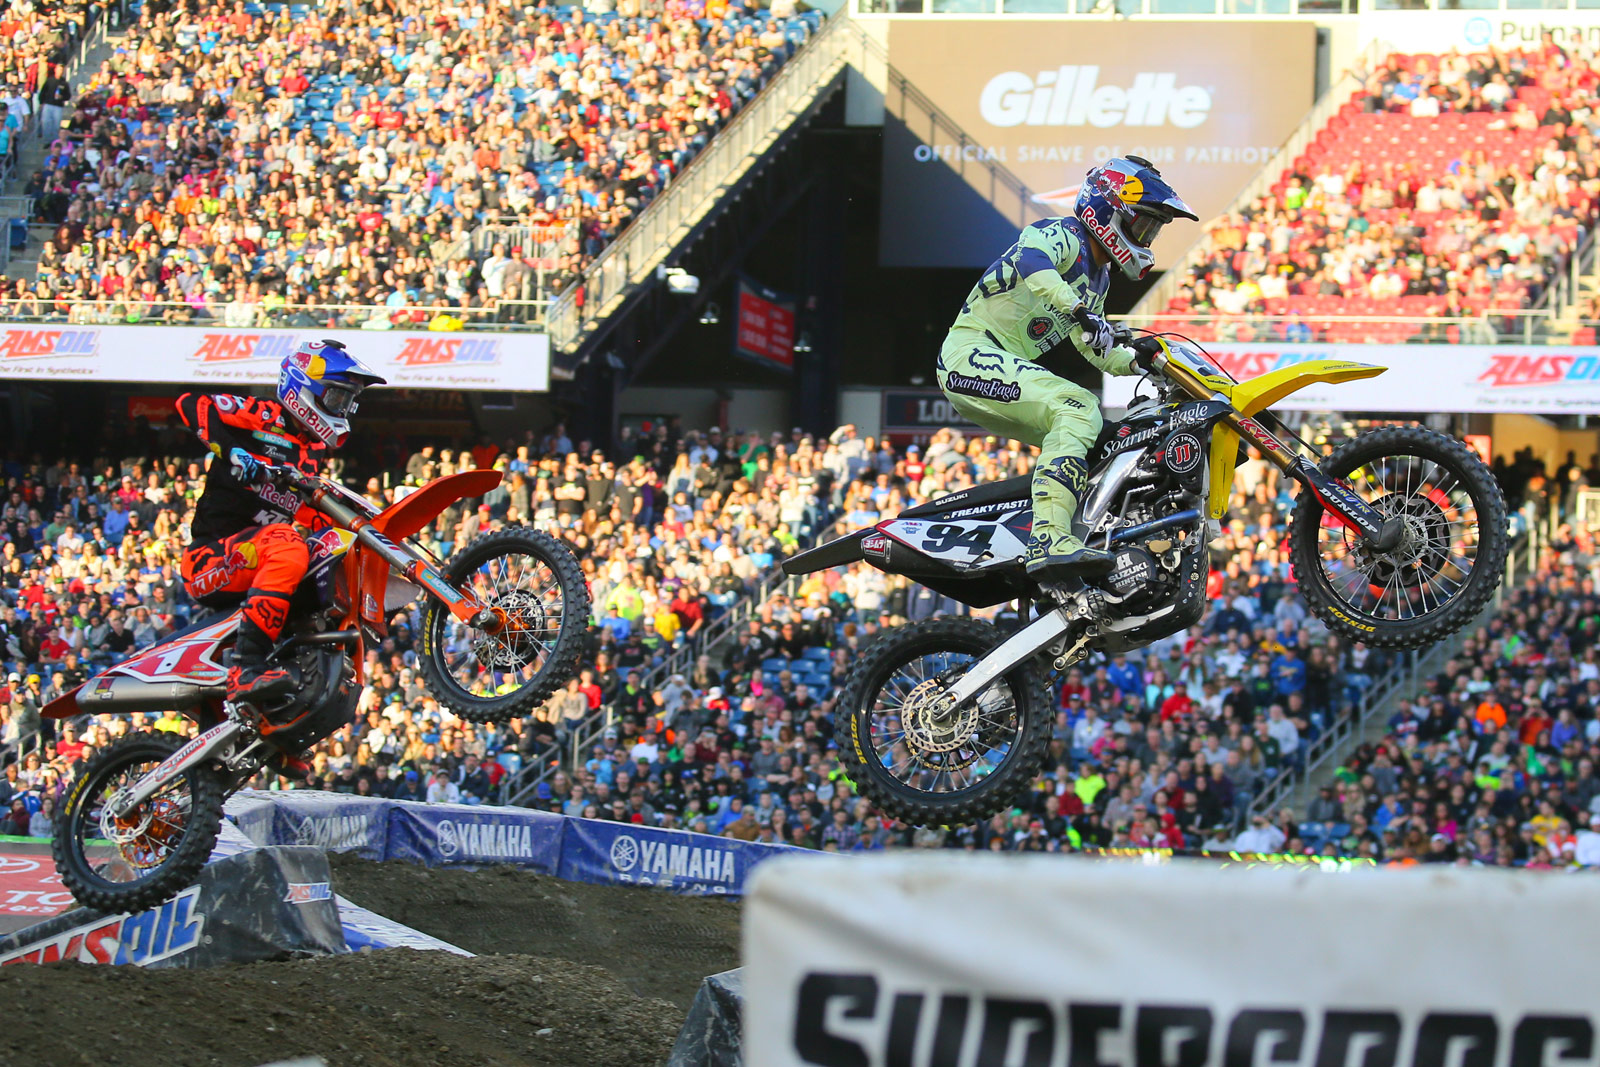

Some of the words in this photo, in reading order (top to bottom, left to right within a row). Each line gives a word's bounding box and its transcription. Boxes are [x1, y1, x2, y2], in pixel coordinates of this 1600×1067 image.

[980, 65, 1212, 128] Gillette
[914, 145, 1007, 163] OFFICIAL
[1018, 145, 1083, 162] SHAVE
[1080, 205, 1111, 238] Red
[0, 330, 96, 358] AMSOIL
[194, 333, 296, 361] AMSOIL
[394, 338, 497, 366] AMSOIL
[948, 371, 992, 395] Soaring
[989, 380, 1021, 401] Eagle
[283, 388, 311, 417] Red
[305, 410, 334, 441] Bull
[1169, 402, 1208, 431] Eagle
[1101, 425, 1161, 460] Soaring
[1237, 418, 1281, 451] KYB
[935, 492, 969, 506] SUZUKI
[951, 505, 995, 519] FREAKY
[995, 499, 1029, 512] FAST!
[1318, 487, 1379, 534] DUNLOP
[922, 524, 998, 555] 94
[191, 567, 230, 599] KTM
[1108, 562, 1149, 584] SUZUKI
[424, 609, 434, 657] DUNLOP
[1328, 605, 1376, 633] DUNLOP
[155, 646, 189, 676] 1
[850, 713, 868, 765] DUNLOP
[65, 772, 90, 816] DUNLOP
[457, 822, 533, 858] YAMAHA
[640, 839, 736, 883] YAMAHA
